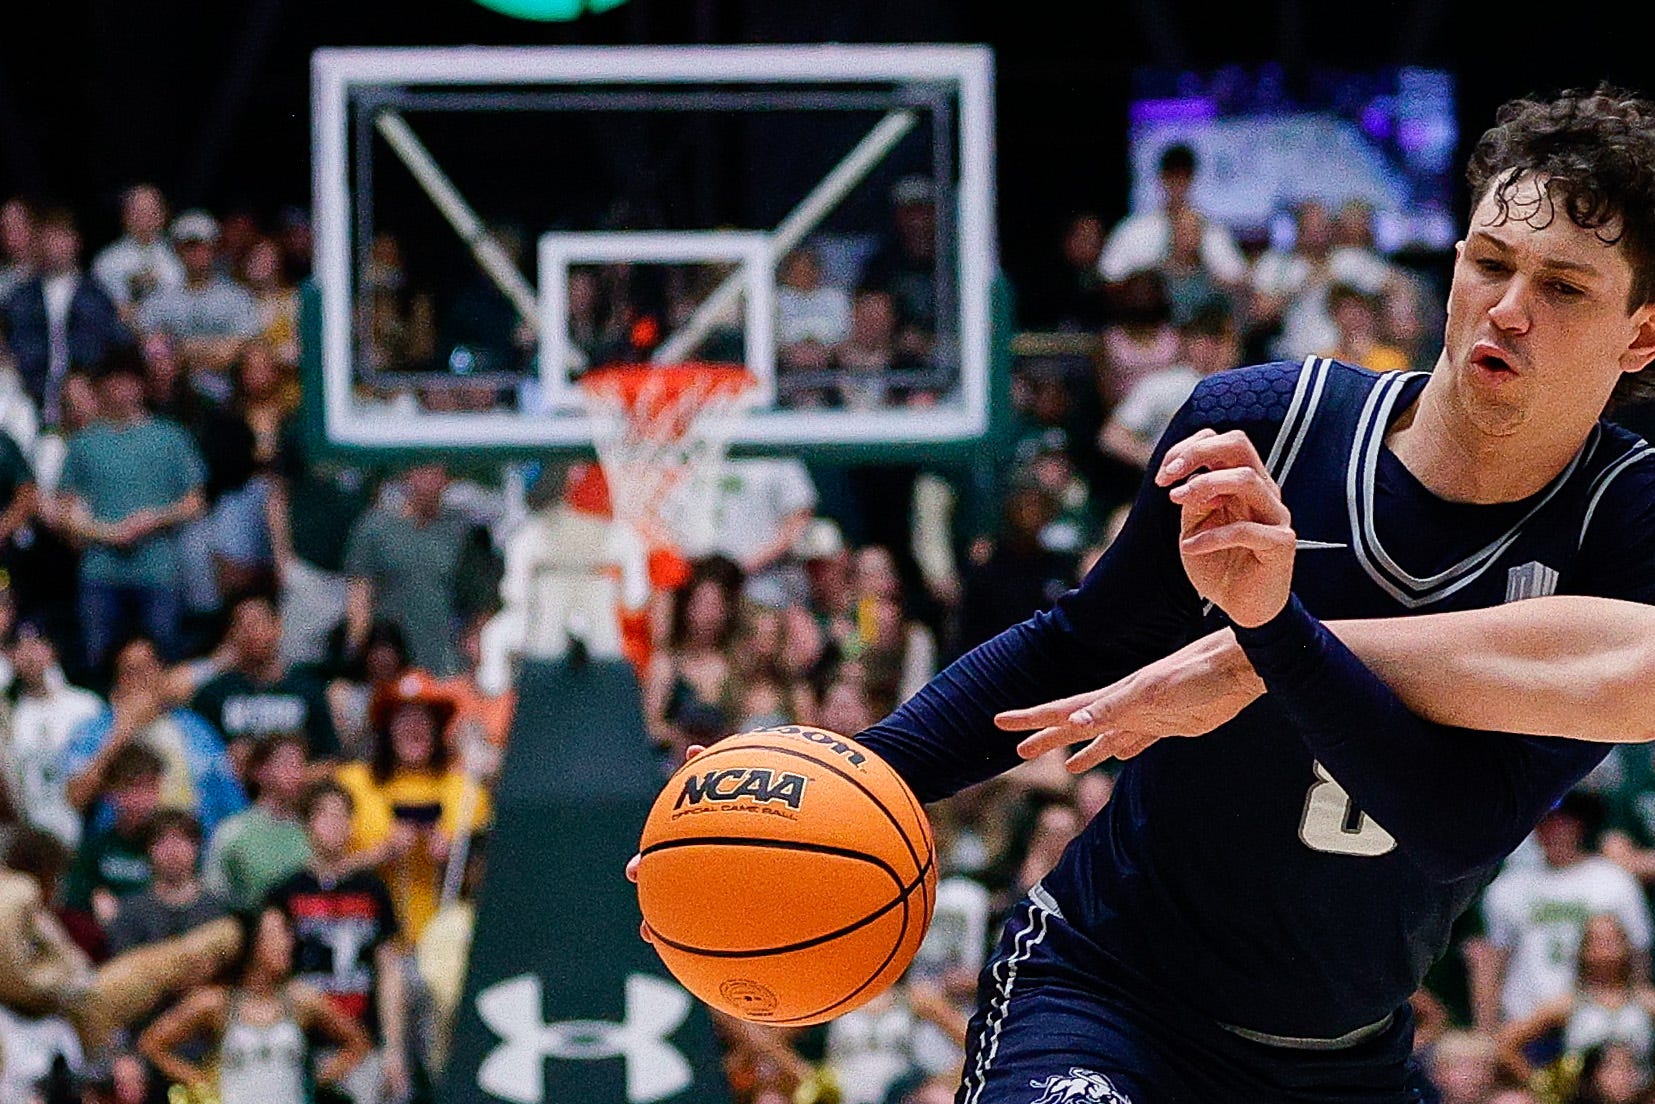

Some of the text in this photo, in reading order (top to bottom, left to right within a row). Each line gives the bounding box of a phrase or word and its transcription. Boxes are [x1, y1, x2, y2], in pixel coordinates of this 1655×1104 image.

[673, 767, 808, 811] NCAA
[720, 804, 760, 814] GAME
[761, 807, 799, 822] BALL
